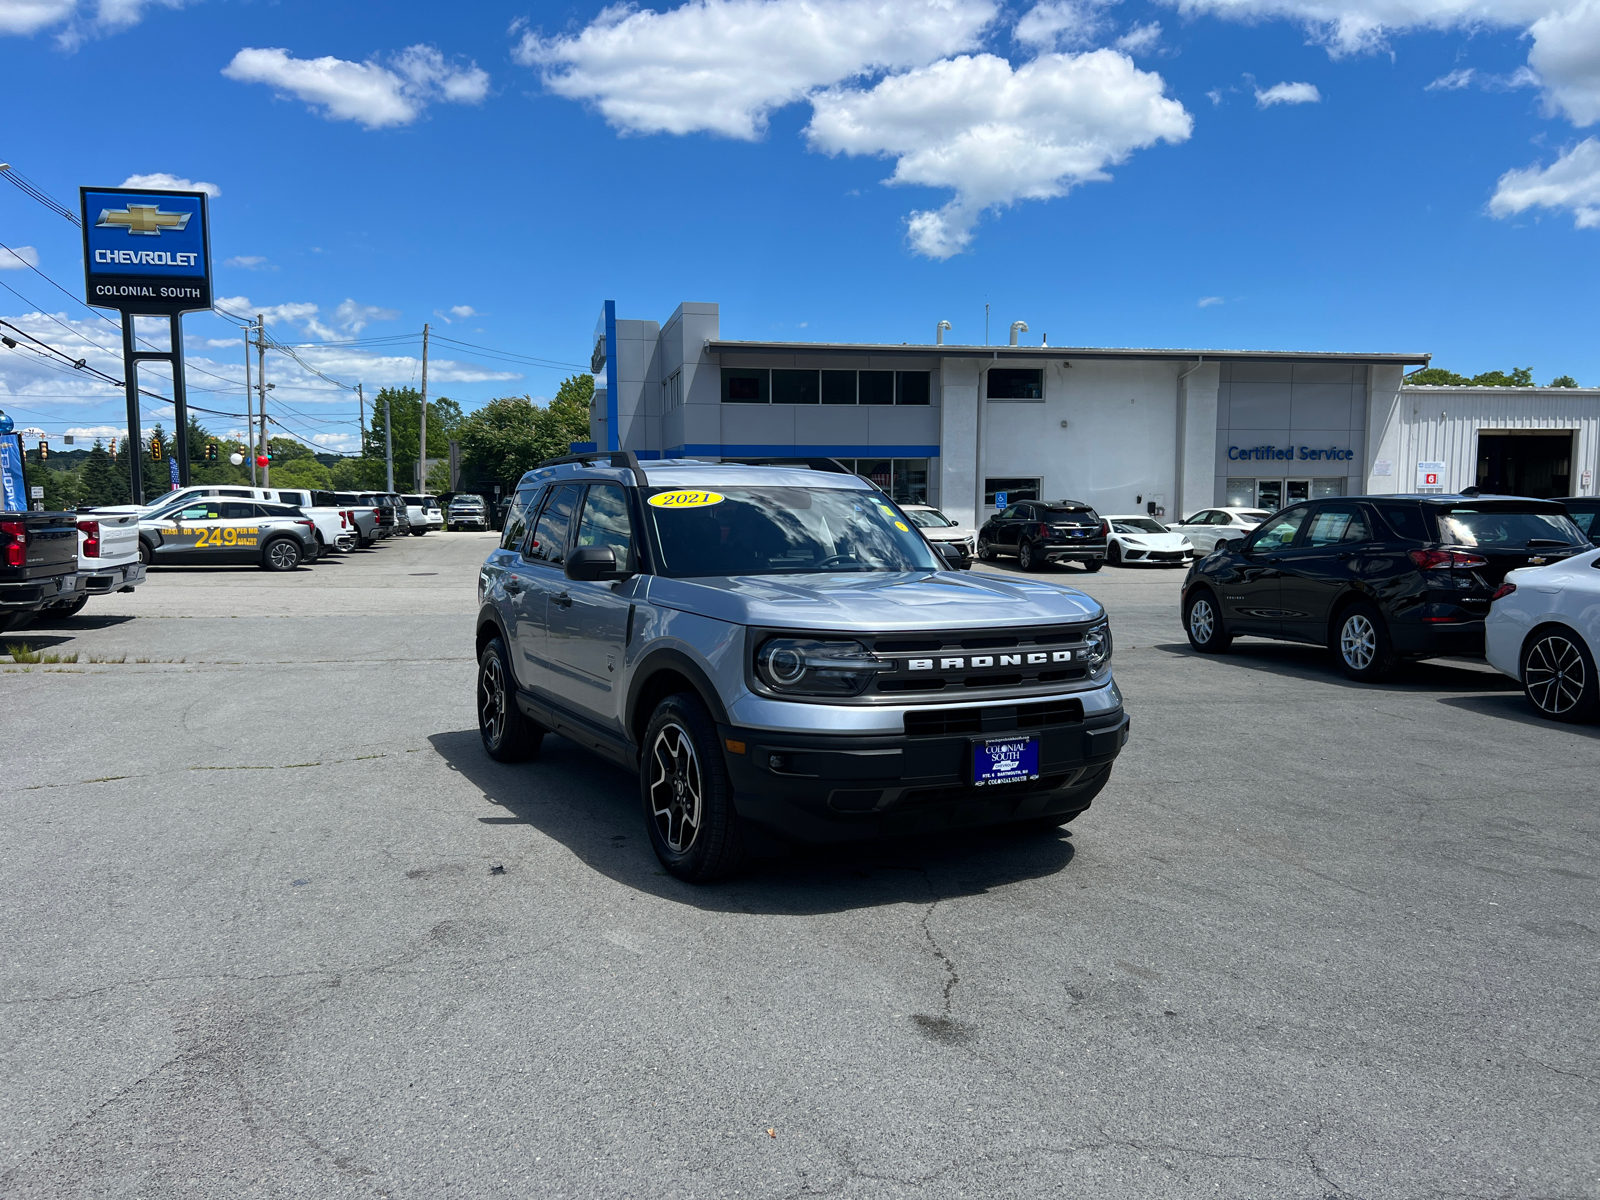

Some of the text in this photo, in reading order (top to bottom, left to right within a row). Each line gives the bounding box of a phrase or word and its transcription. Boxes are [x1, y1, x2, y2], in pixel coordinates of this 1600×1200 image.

[95, 249, 198, 266] CHEVROLET
[96, 285, 201, 298] COLONIAL SOUTH
[1228, 445, 1354, 460] Certified Service
[1428, 475, 1435, 483] 6
[662, 493, 710, 506] 2021
[908, 651, 1071, 671] BRONCO
[985, 743, 1026, 754] COLONIAL
[991, 751, 1020, 761] SOUTH
